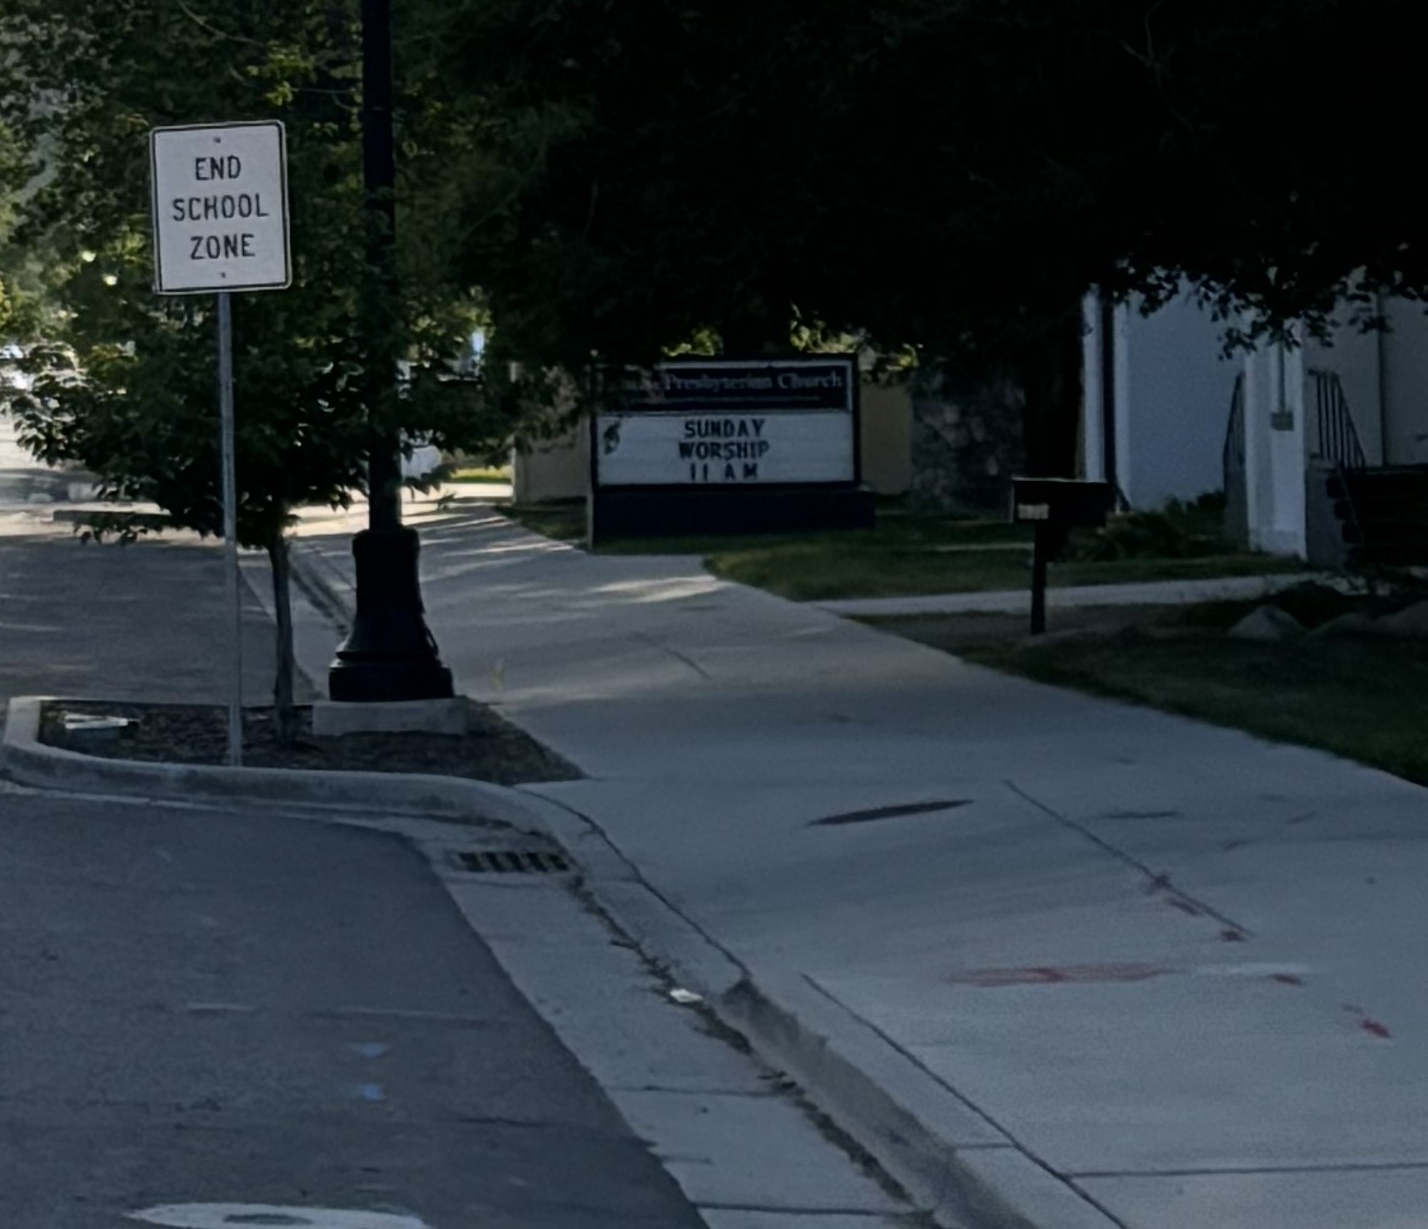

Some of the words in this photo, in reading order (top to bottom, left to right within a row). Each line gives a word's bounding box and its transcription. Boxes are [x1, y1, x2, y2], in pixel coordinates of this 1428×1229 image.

[195, 155, 241, 181] END
[172, 193, 269, 221] SCHOOL
[190, 233, 256, 260] ZONE
[664, 372, 773, 392] Presbyterian
[777, 370, 843, 389] Church
[684, 419, 765, 438] SUNDAY
[678, 439, 770, 461] WORSHIP
